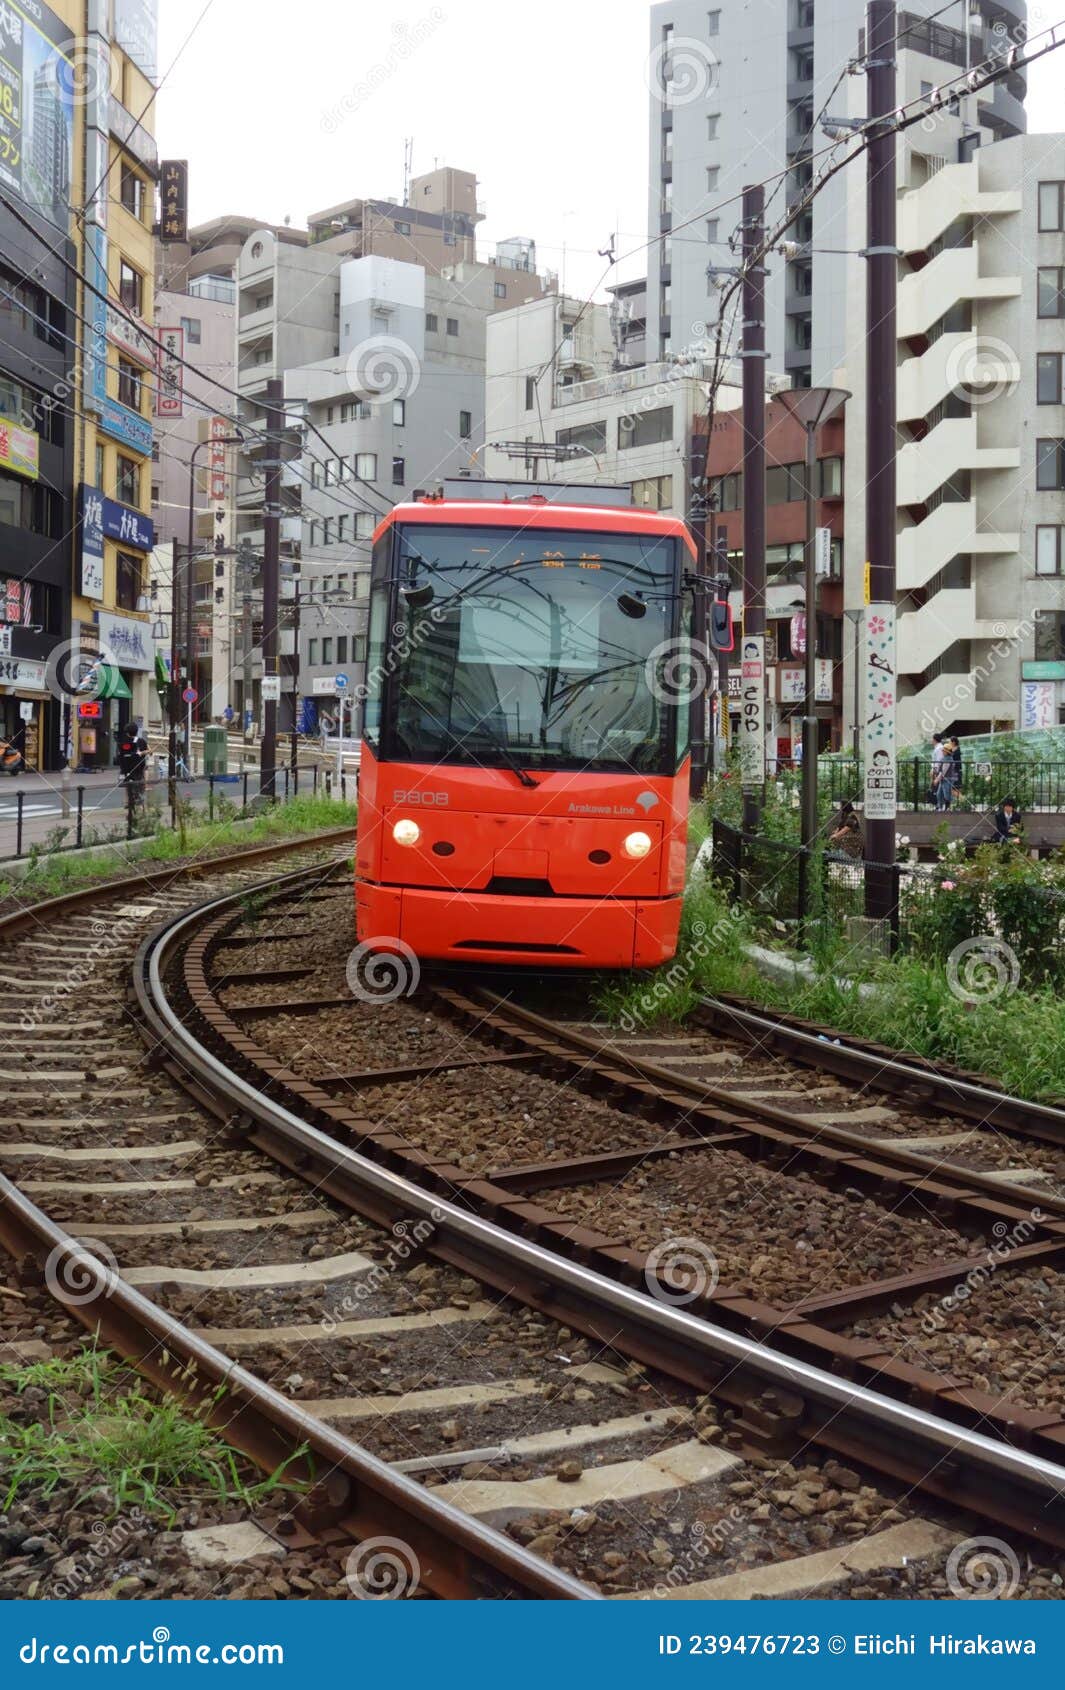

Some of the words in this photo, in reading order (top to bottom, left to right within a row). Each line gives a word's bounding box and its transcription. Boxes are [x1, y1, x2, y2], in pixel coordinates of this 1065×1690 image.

[743, 685, 760, 733] さのや
[567, 802, 612, 815] Arakawa
[613, 804, 636, 816] Line
